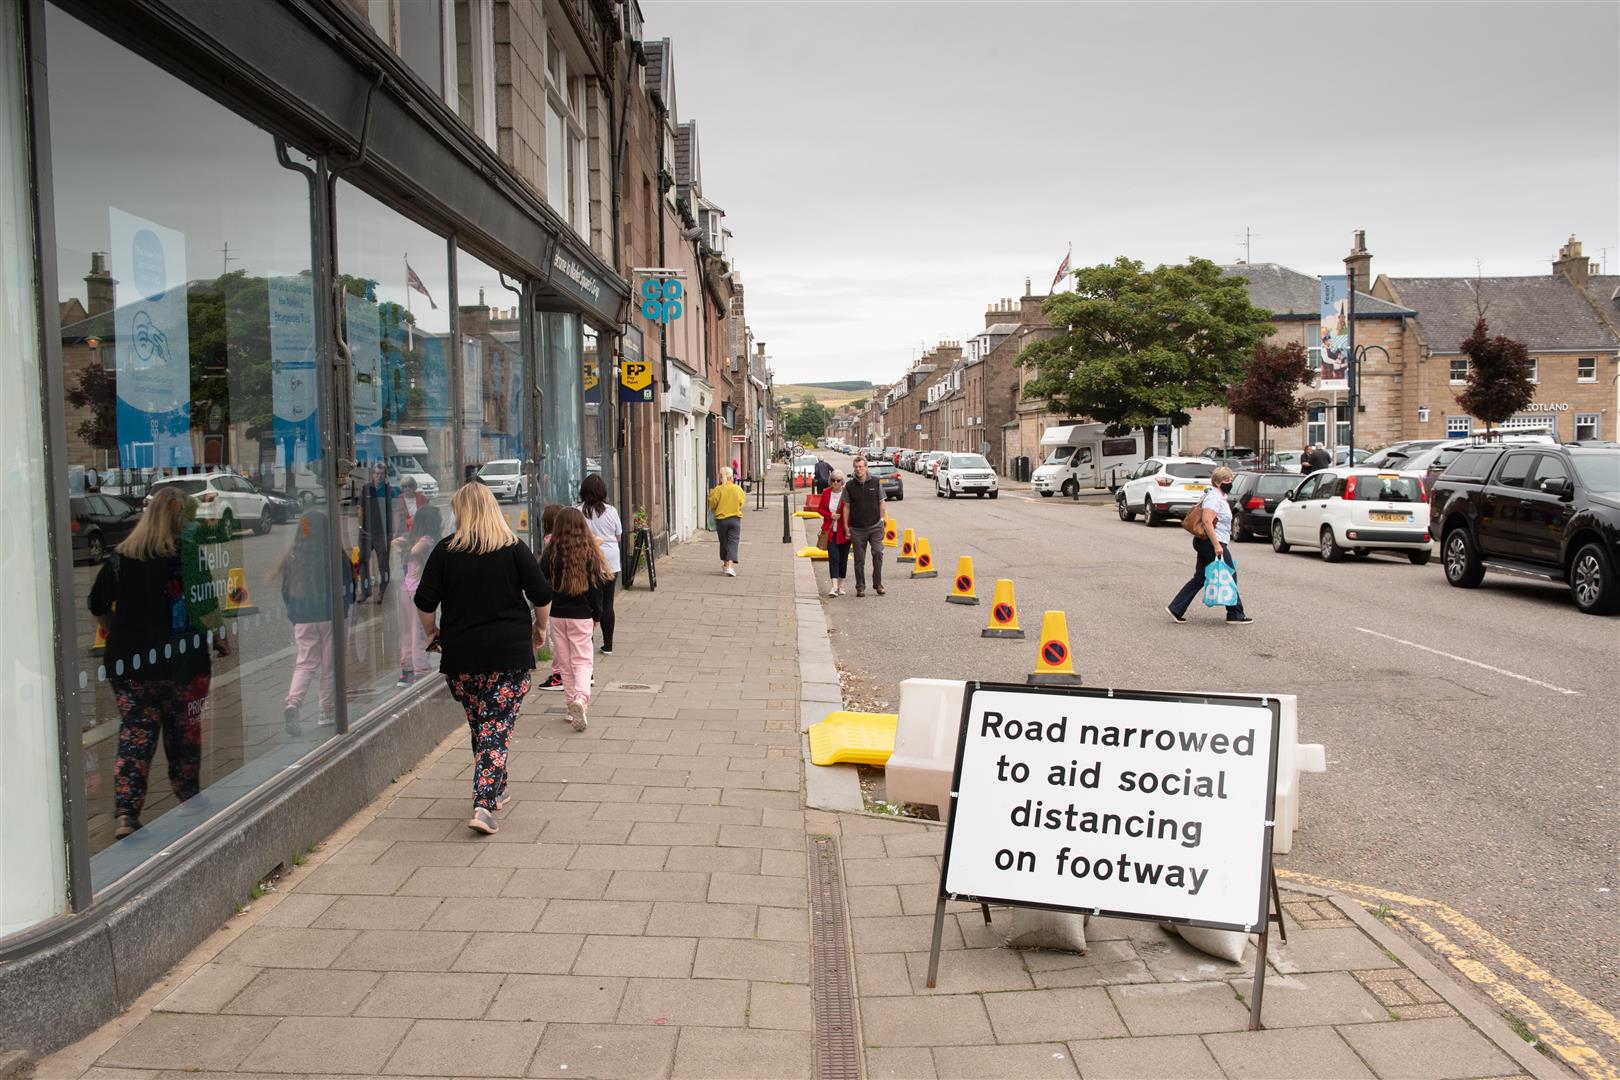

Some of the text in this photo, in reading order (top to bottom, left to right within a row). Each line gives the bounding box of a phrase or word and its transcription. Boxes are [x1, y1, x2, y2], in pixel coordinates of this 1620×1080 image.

[198, 543, 230, 571] Hello
[190, 575, 239, 603] summer
[980, 711, 1255, 756] Road narrowed
[996, 755, 1228, 799] to aid social
[1010, 799, 1202, 848] distancing
[994, 847, 1209, 895] on footway
